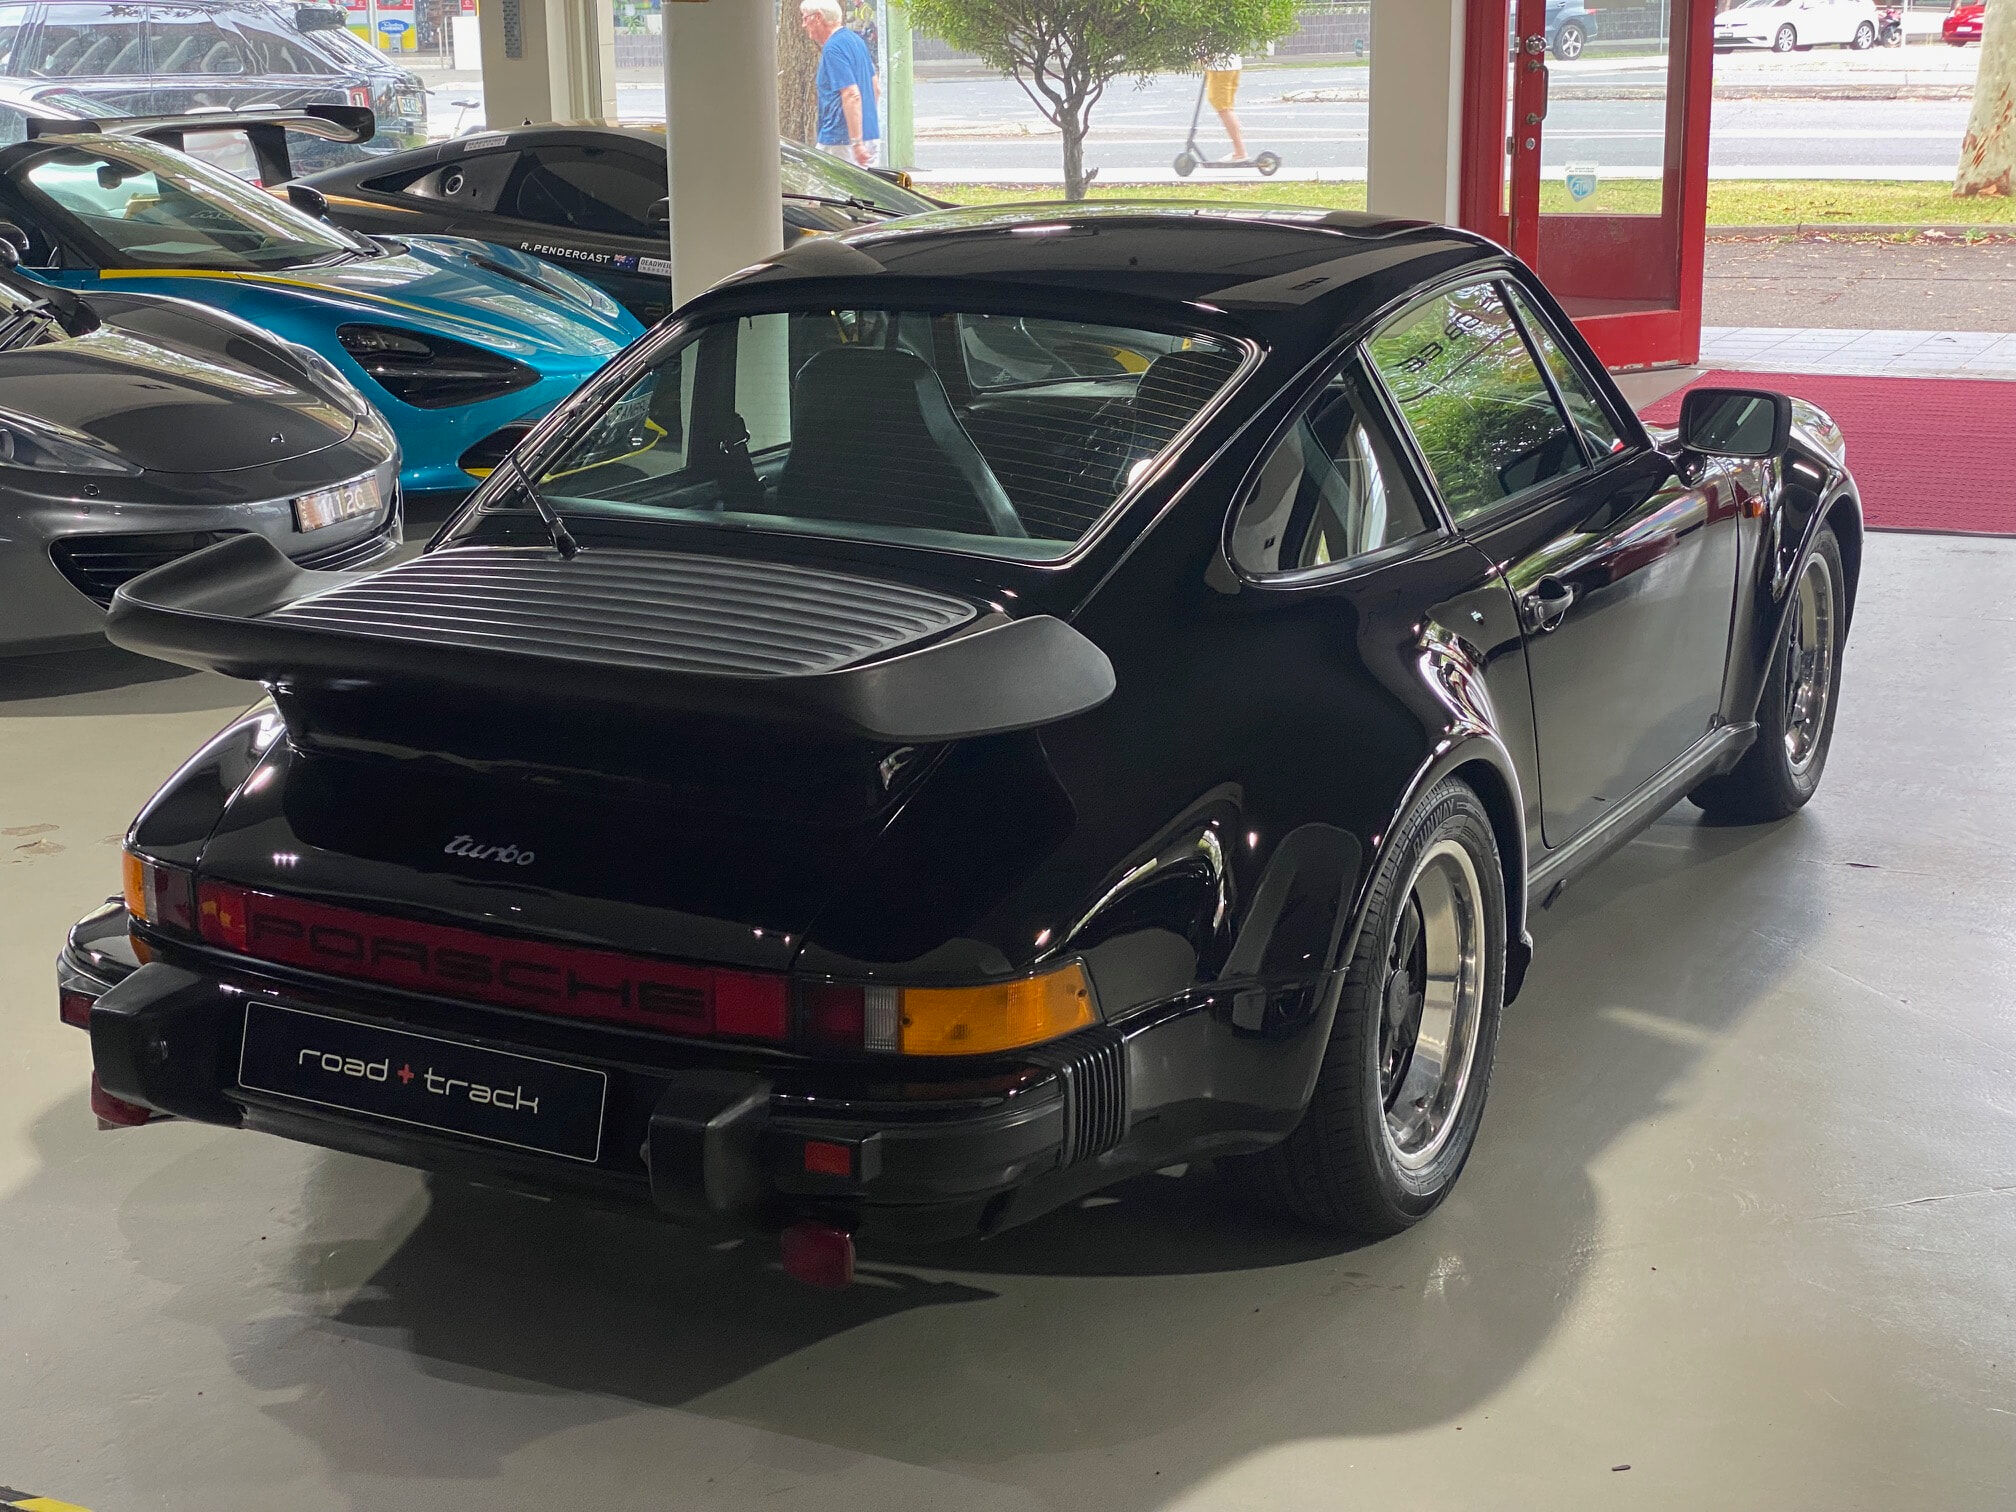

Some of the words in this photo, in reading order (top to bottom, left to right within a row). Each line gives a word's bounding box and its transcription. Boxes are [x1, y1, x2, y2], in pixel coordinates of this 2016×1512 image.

[520, 241, 611, 264] R.PENDERGAST
[444, 834, 535, 866] turbo
[254, 916, 702, 1014] PORSCHE
[299, 1049, 389, 1082] road
[424, 1067, 539, 1114] track
